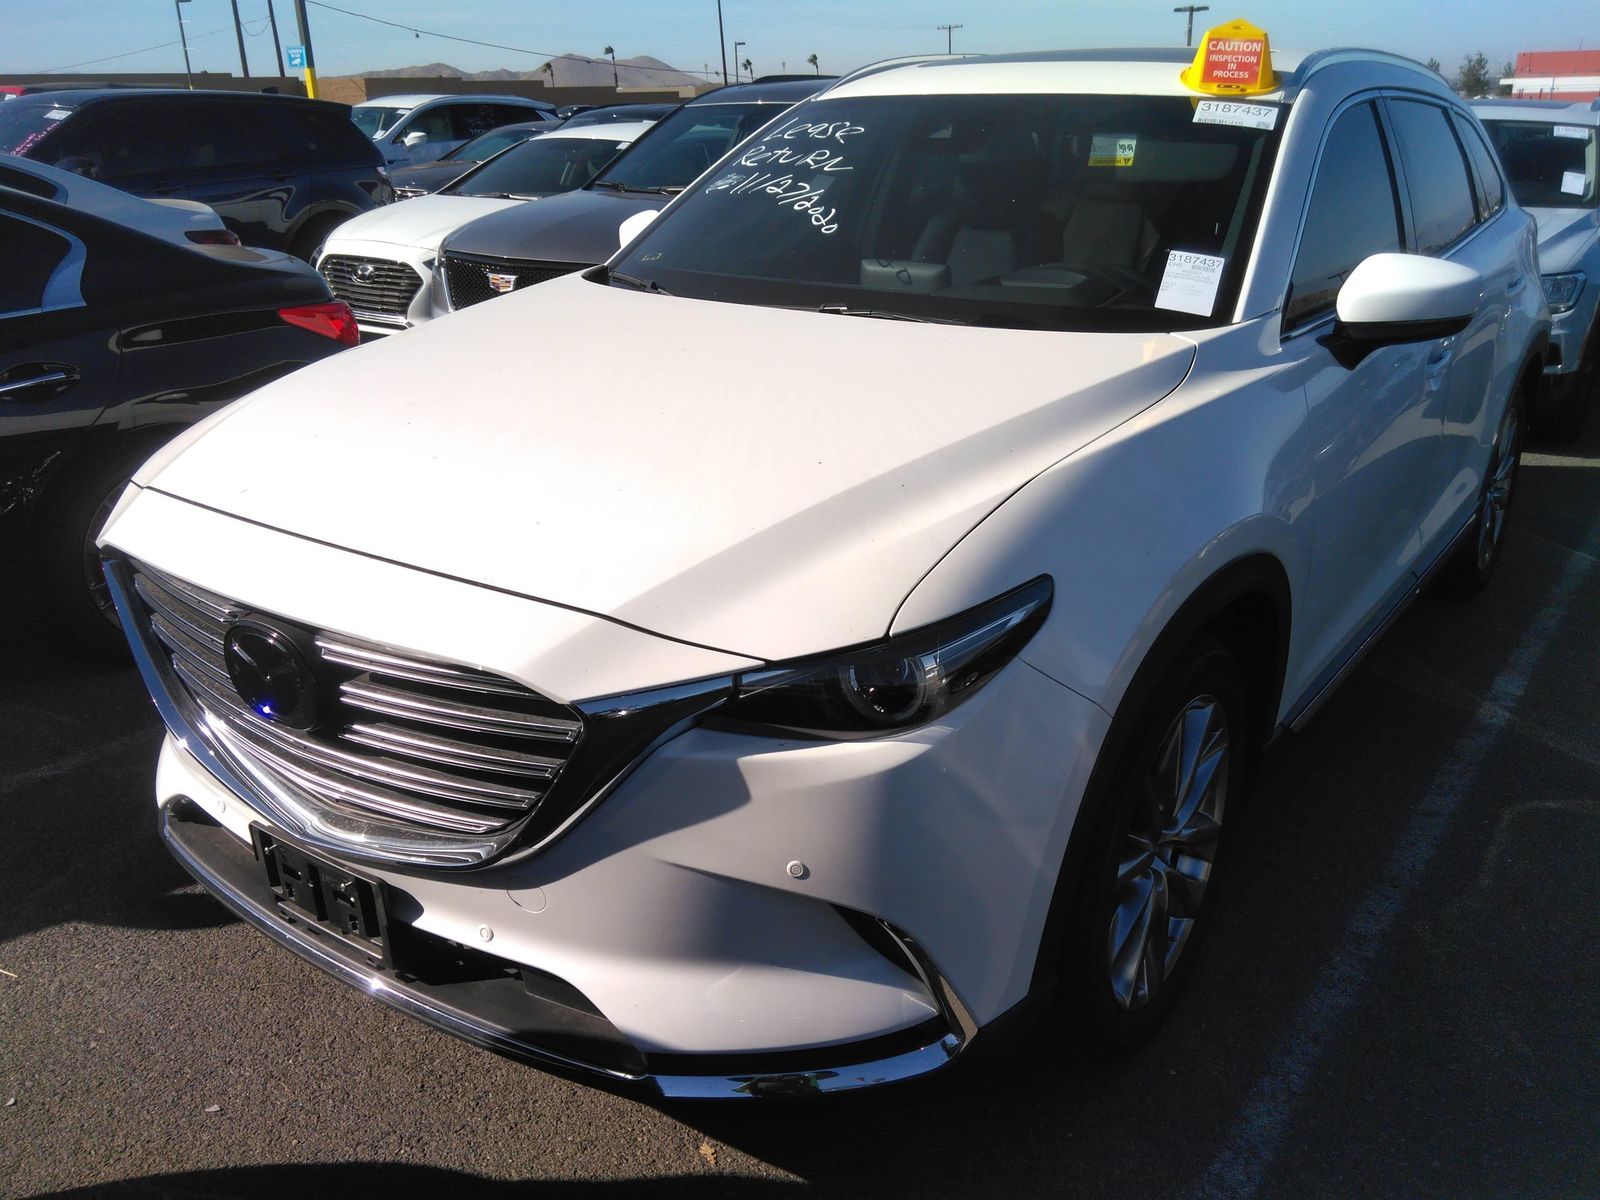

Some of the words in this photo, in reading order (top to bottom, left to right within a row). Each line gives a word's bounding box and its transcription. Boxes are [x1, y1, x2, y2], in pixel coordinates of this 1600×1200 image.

[1208, 40, 1261, 52] CAUTION
[1209, 54, 1257, 64] INSPECTION
[1212, 70, 1249, 79] PROCESS
[1201, 102, 1273, 117] 3187437
[1168, 253, 1222, 269] 3187437
